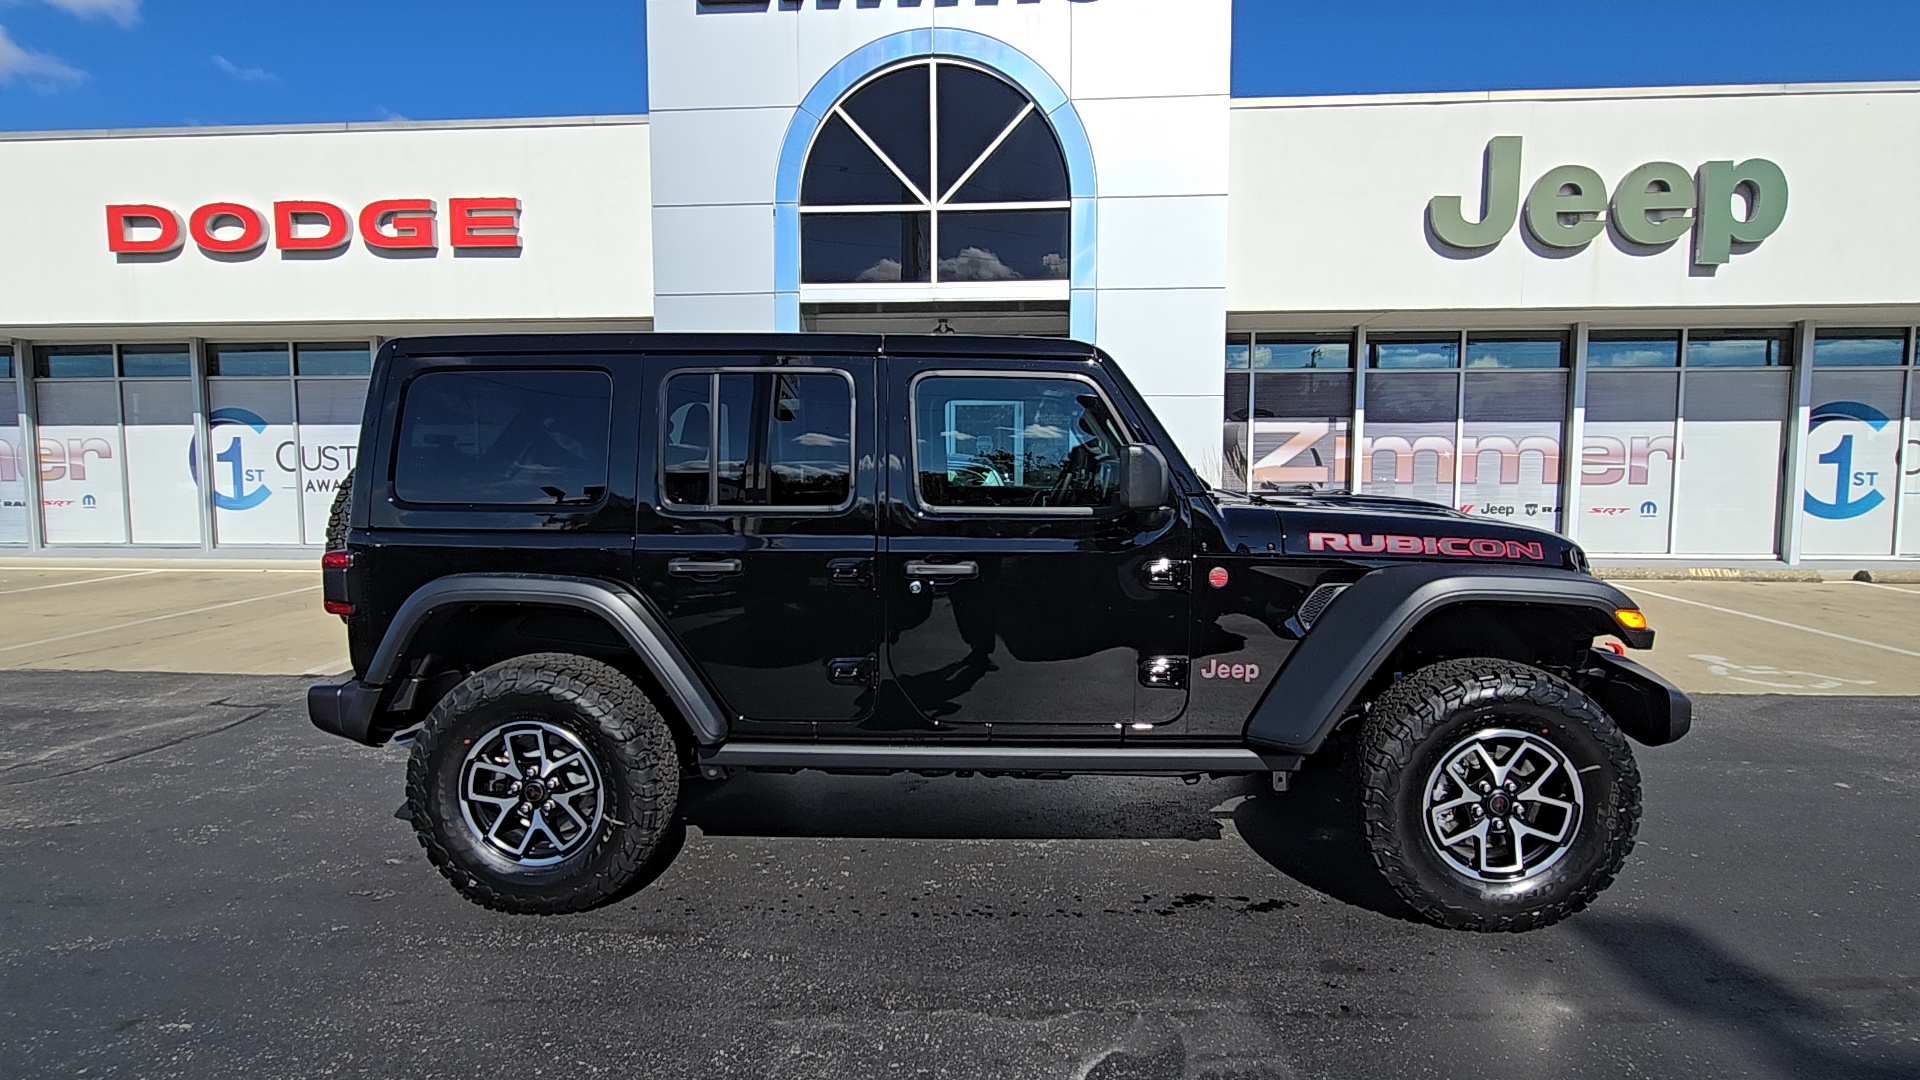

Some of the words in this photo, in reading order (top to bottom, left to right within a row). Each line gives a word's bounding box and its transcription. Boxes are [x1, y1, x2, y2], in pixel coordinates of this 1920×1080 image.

[1426, 135, 1789, 268] Jeep
[105, 197, 520, 256] DODGE
[1253, 421, 1685, 486] Zimmer
[43, 500, 76, 508] SRT
[1480, 502, 1515, 517] Jeep
[1541, 506, 1563, 514] RA
[1588, 507, 1632, 516] SRT
[1308, 532, 1544, 561] RUBICON
[1201, 658, 1260, 683] Jeep
